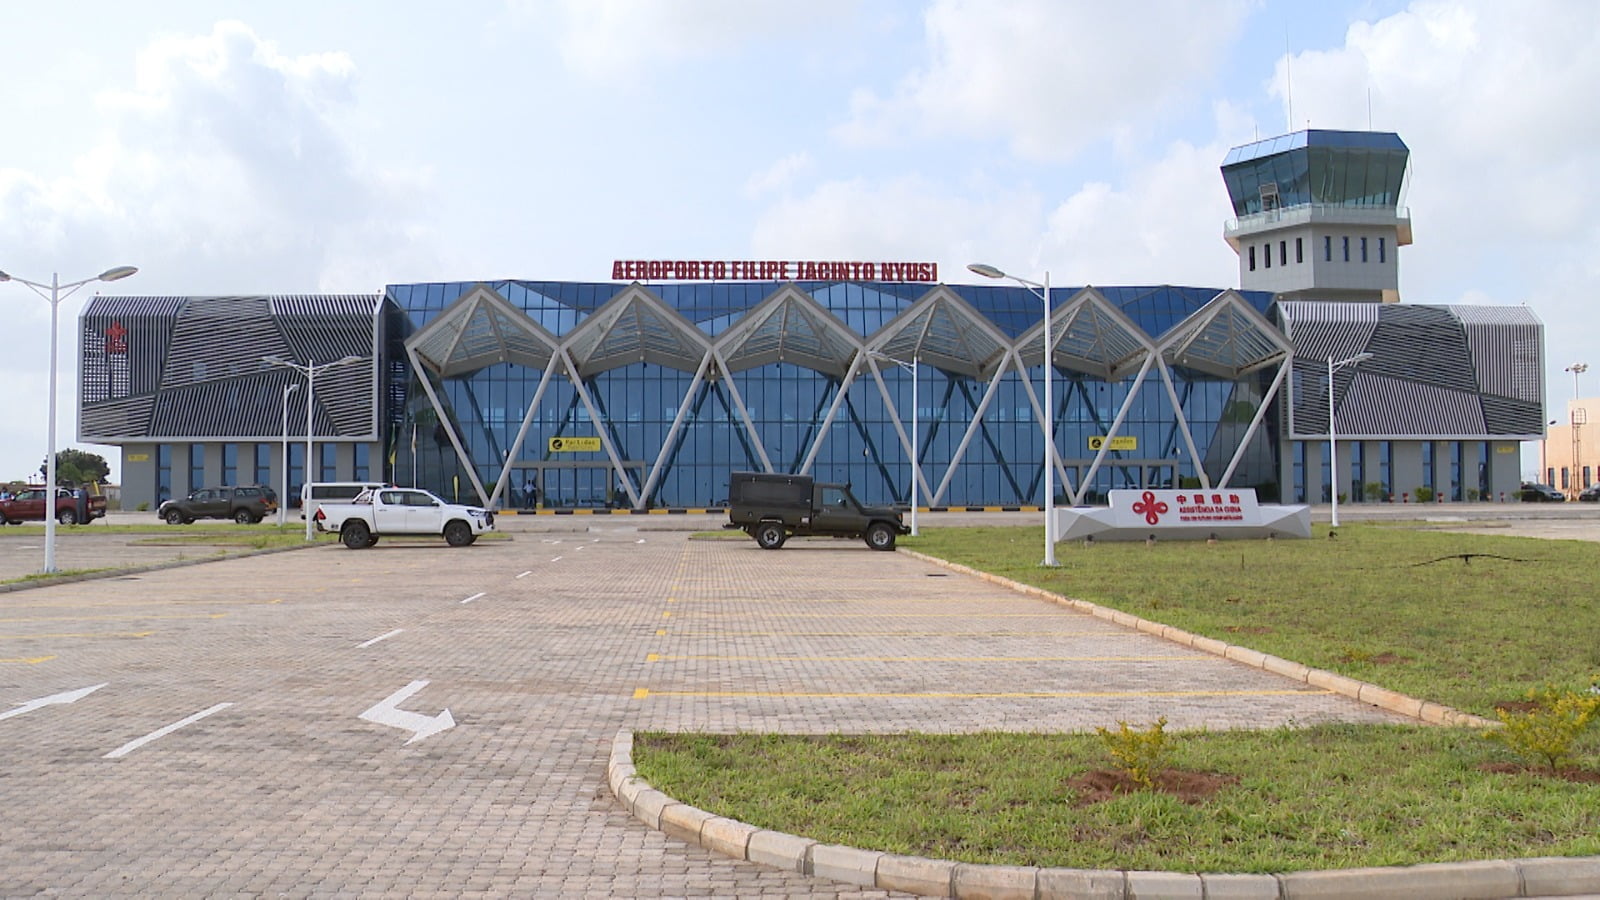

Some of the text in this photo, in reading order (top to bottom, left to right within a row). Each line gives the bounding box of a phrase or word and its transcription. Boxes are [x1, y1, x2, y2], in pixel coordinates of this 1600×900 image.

[612, 261, 938, 282] AEROPORTO FILIPE JACINTO NYUSI
